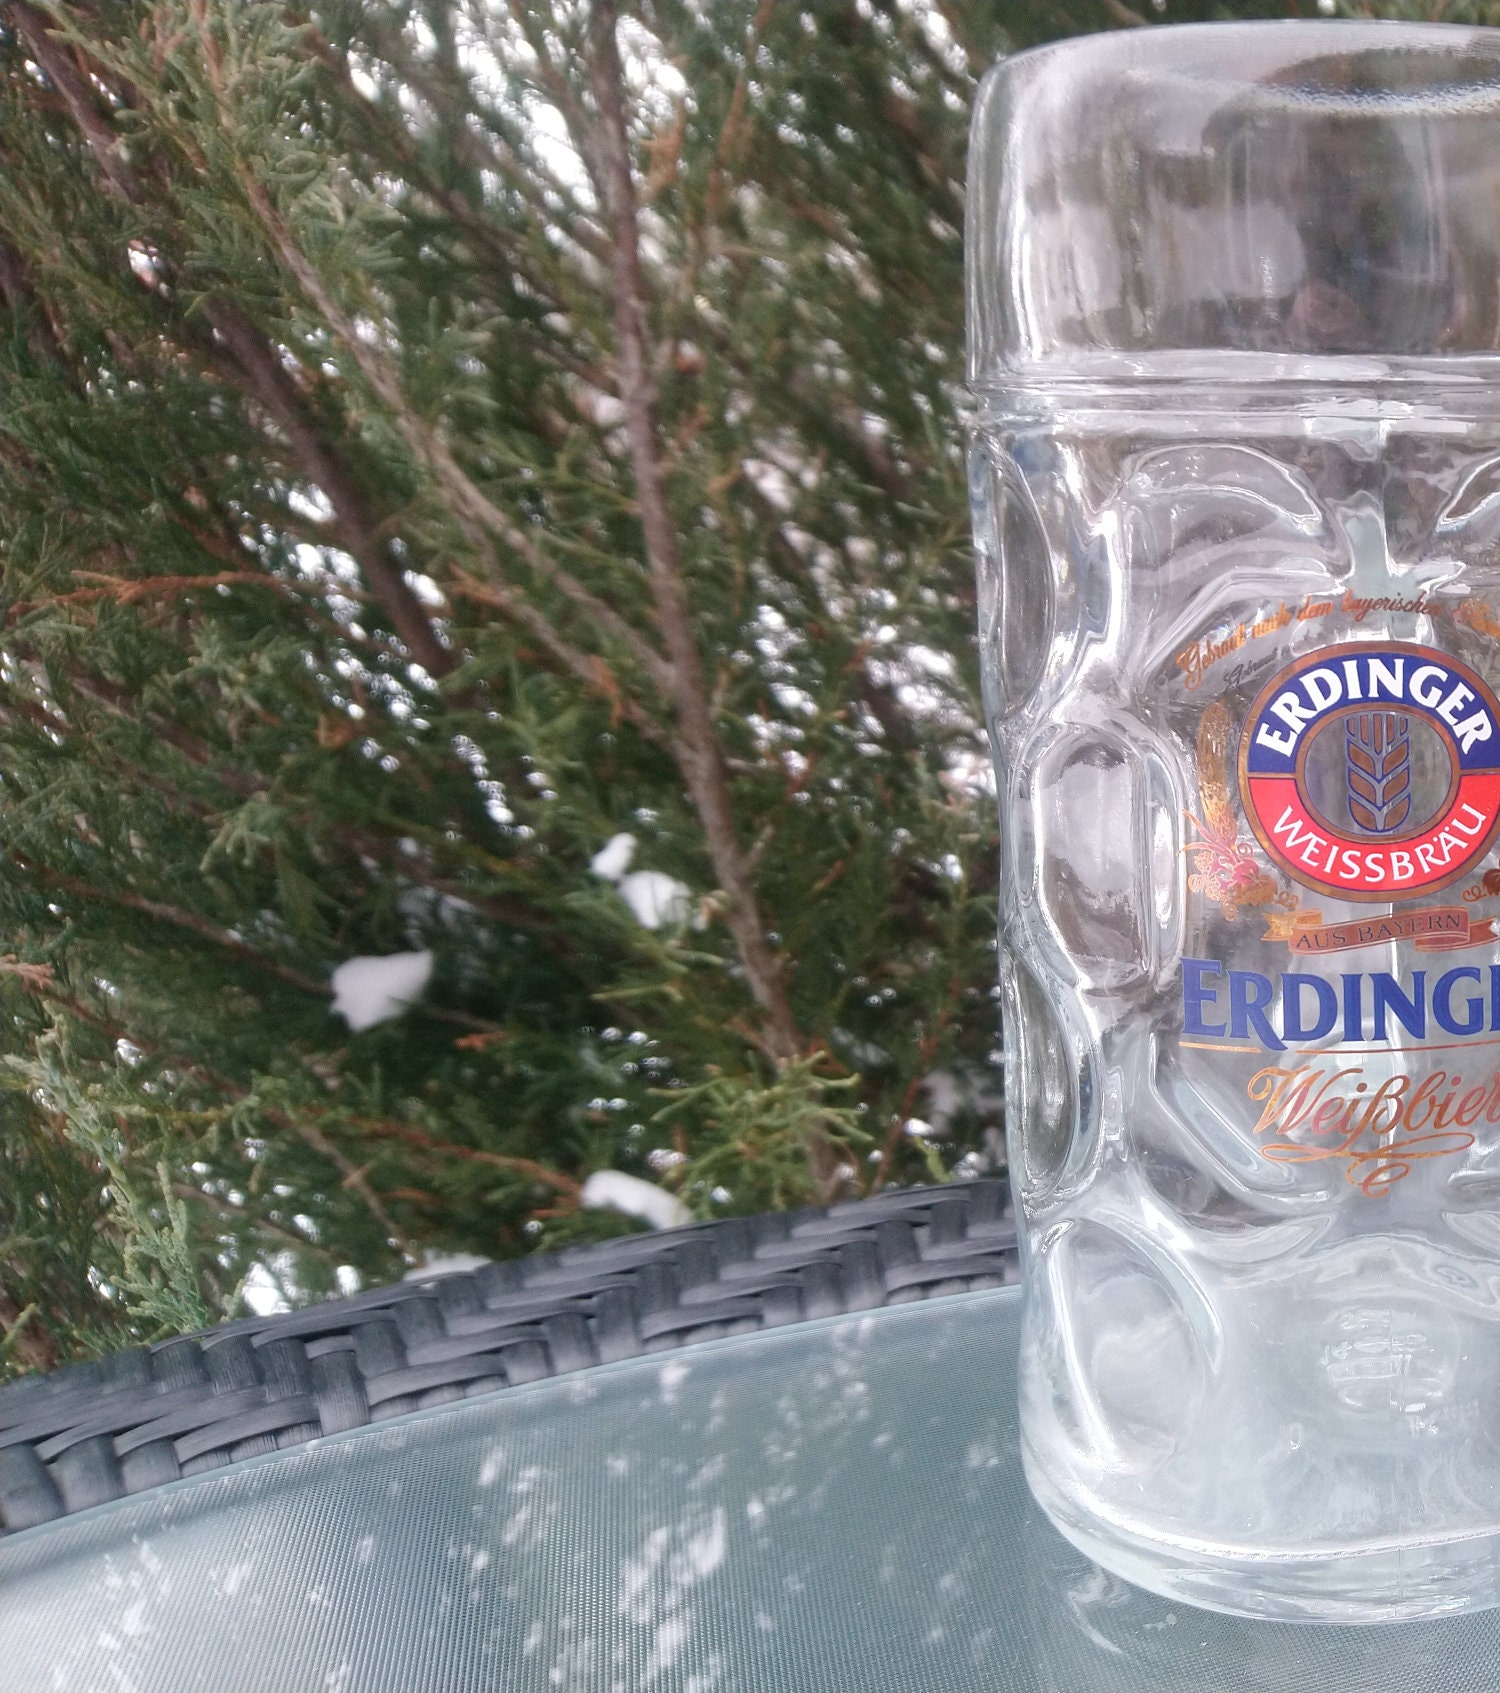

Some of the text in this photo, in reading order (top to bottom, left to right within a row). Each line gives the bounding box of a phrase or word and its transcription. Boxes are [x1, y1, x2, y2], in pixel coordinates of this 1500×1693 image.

[1255, 658, 1493, 757] ERDINGER
[1273, 802, 1487, 883] WEISSBRÄU
[1296, 914, 1461, 949] AUS BAYERN
